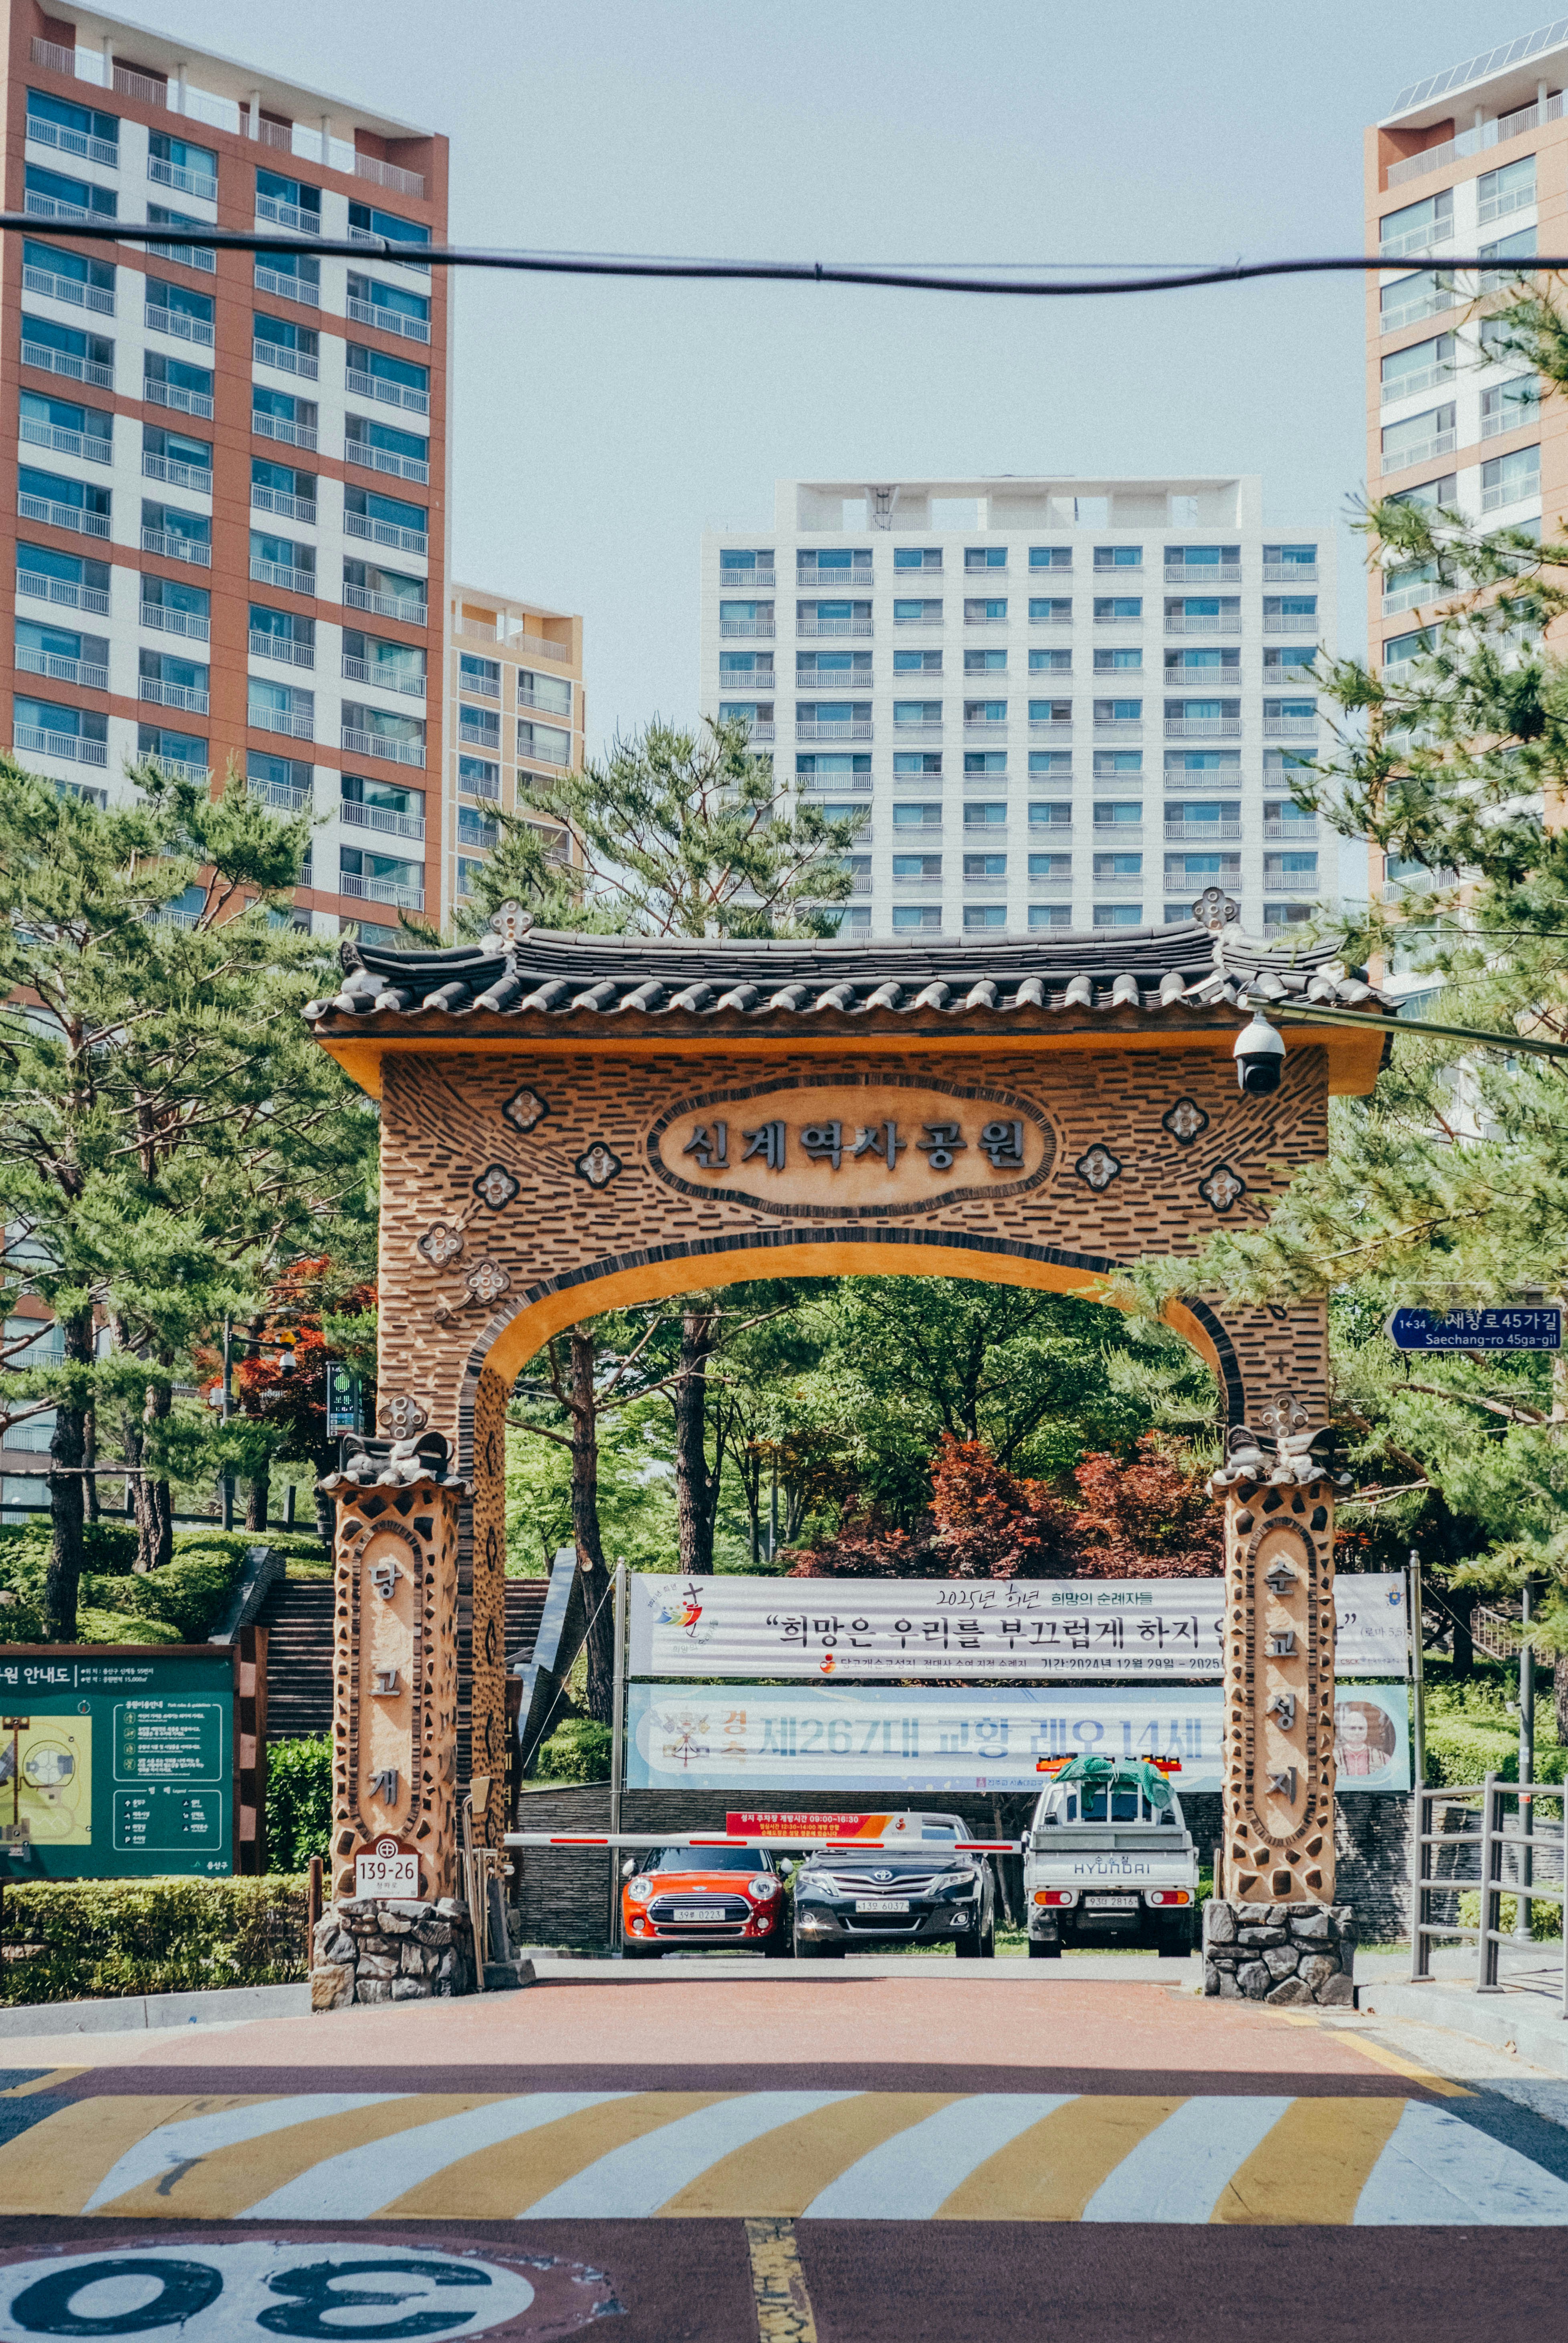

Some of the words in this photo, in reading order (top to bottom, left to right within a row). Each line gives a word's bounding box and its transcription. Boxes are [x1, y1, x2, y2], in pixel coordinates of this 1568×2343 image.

[683, 1120, 1024, 1170] 신계역사공원
[1425, 1334, 1504, 1346] Saechang-ro
[1507, 1334, 1556, 1346] 45ga-gil
[936, 1589, 997, 1610] 2025년
[1005, 1583, 1042, 1609] 희년
[1051, 1592, 1092, 1606] 희망의
[1097, 1592, 1153, 1606] 순례자들
[888, 1617, 985, 1649] 우리를
[996, 1617, 1123, 1649] 부끄럽게
[1136, 1616, 1199, 1649] 하지
[1118, 1659, 1143, 1669] 12월
[1148, 1658, 1174, 1669] 29일
[1189, 1658, 1224, 1669] 2025
[0, 1667, 18, 1684] 원
[24, 1667, 70, 1684] 안내도
[368, 1564, 402, 1806] 당고개
[758, 1717, 919, 1758] 제267대
[934, 1717, 1012, 1758] 교황
[1030, 1718, 1107, 1758] 레오
[1119, 1718, 1202, 1758] 14세
[360, 1862, 414, 1879] 139-26
[1075, 1864, 1149, 1874] HYUNDAI
